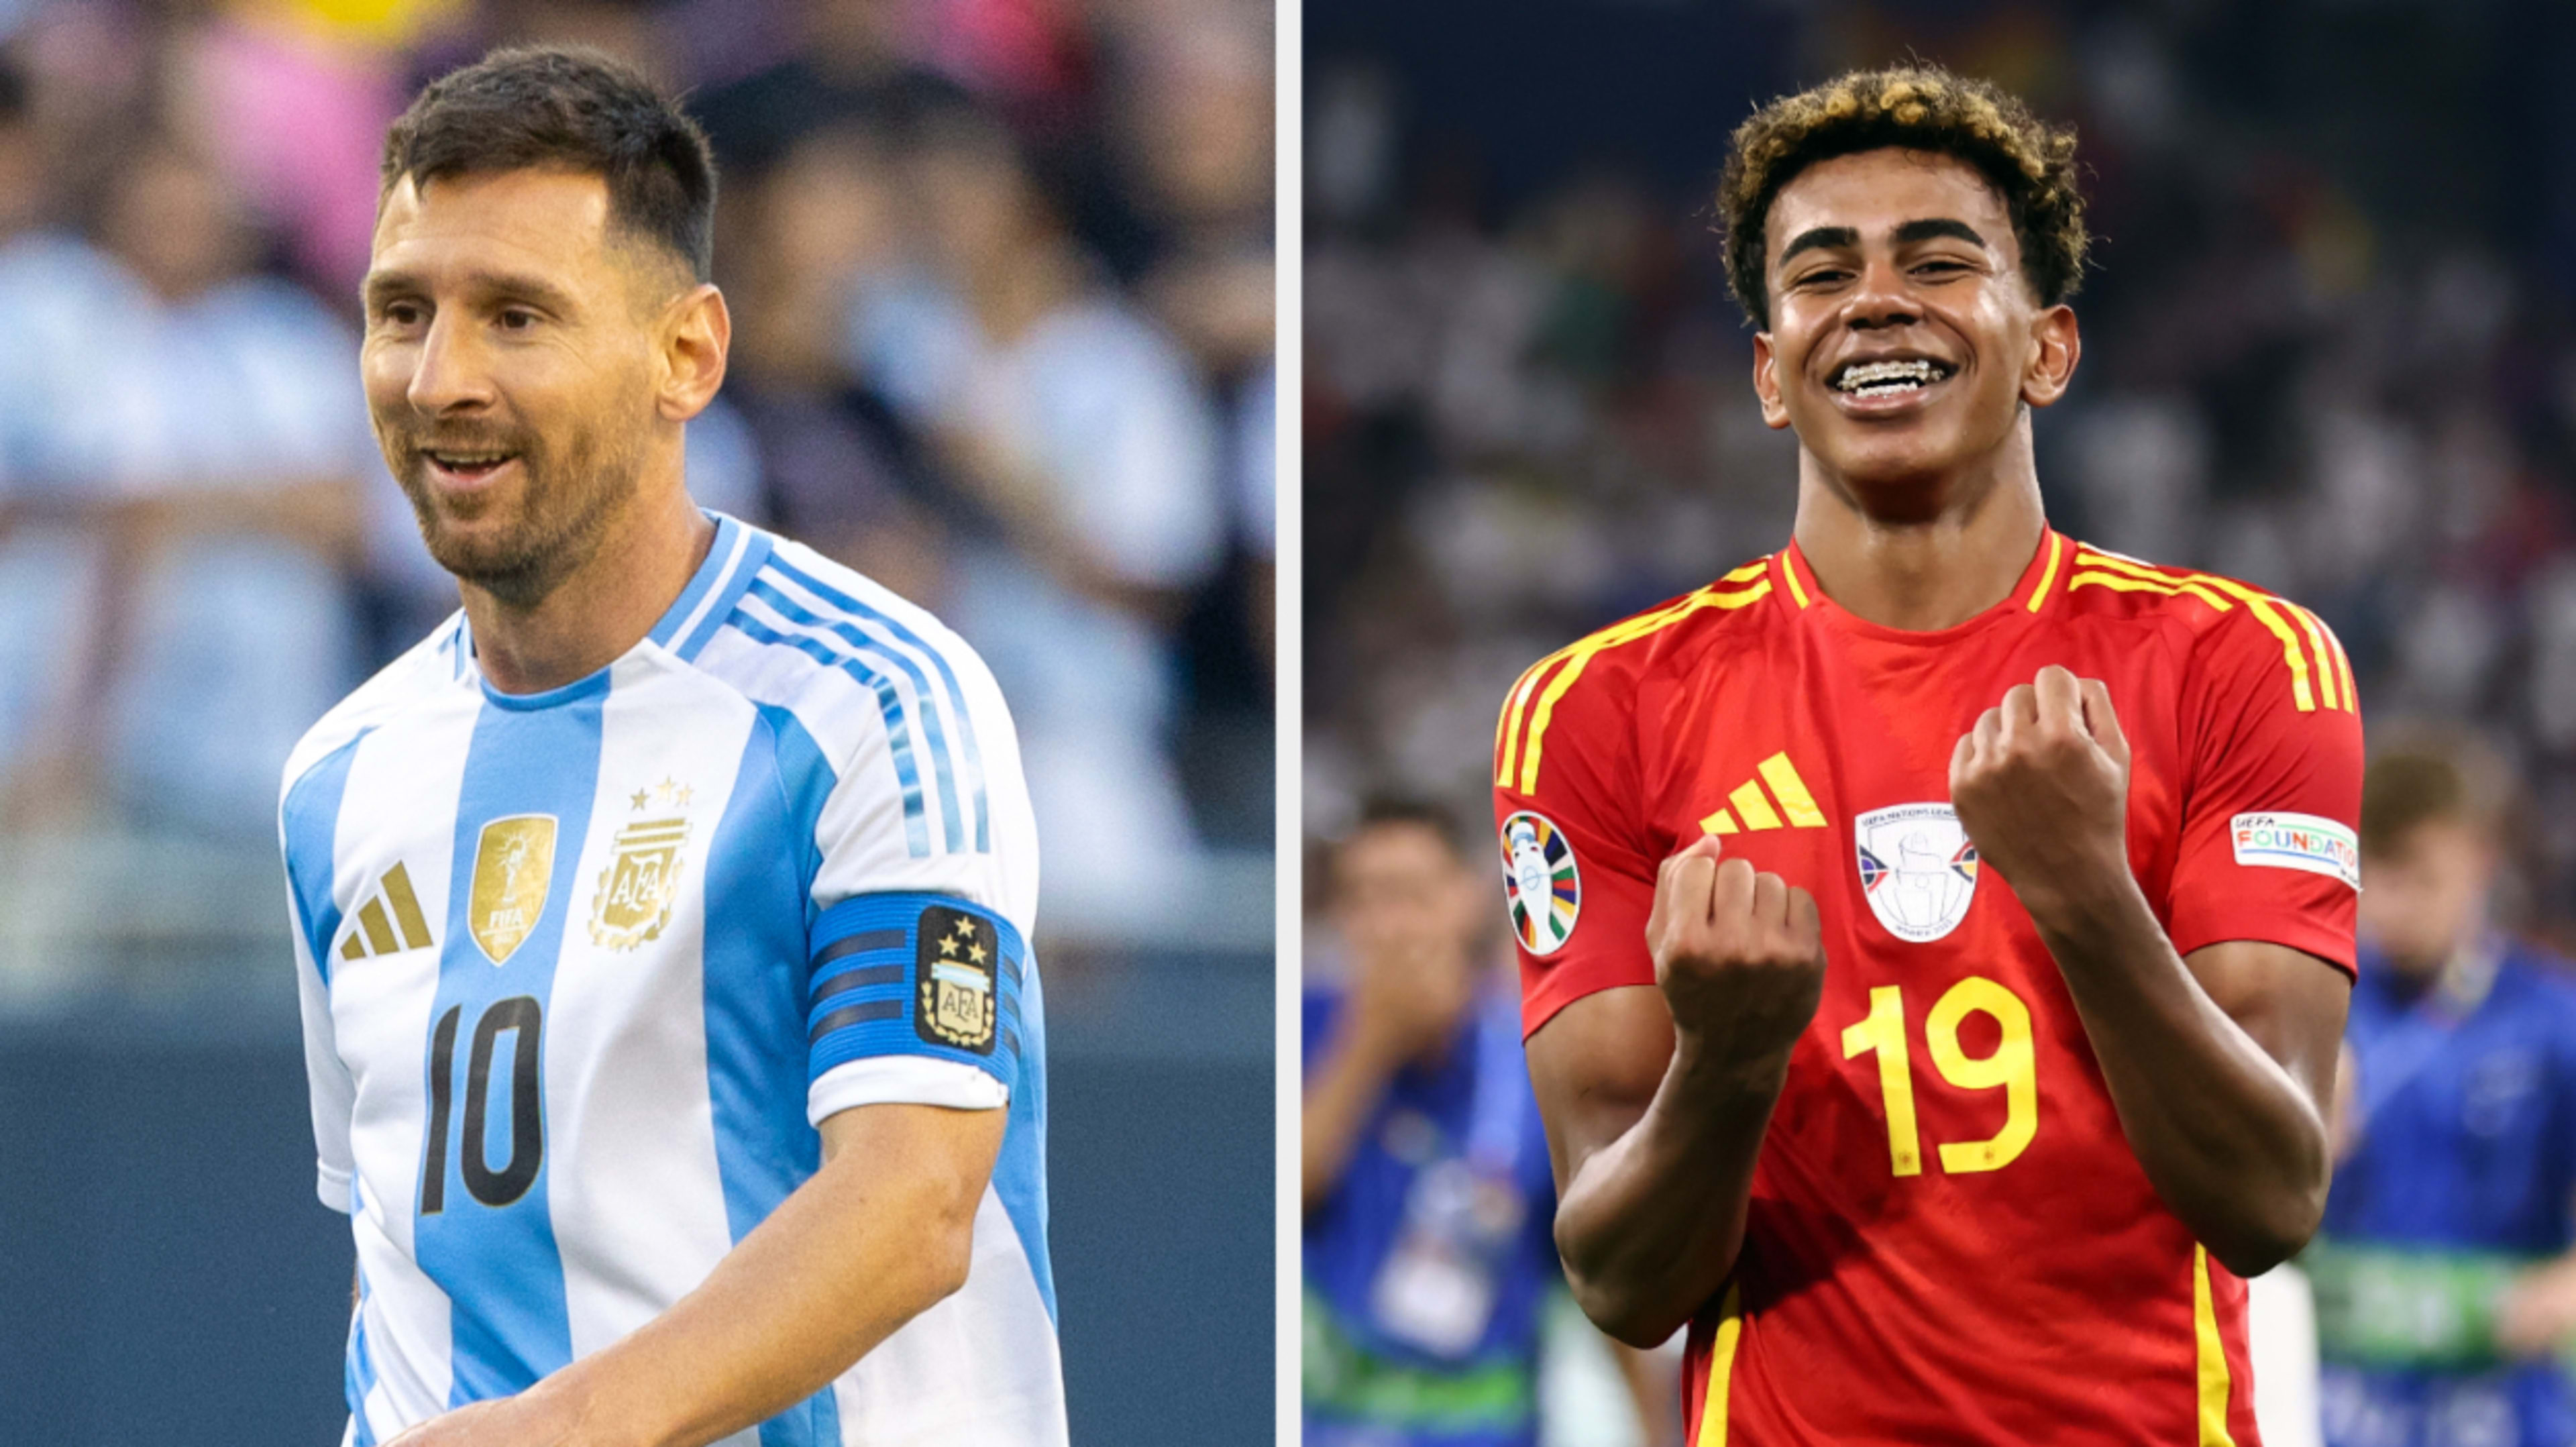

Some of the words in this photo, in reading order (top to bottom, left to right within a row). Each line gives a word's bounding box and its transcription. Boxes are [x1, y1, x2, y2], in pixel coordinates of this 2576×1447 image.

[1931, 808, 1955, 817] LEAG
[2235, 816, 2275, 828] UEFA
[2237, 830, 2359, 867] FOUNDATIO
[610, 853, 662, 911] AFA
[489, 907, 523, 929] FIFA
[942, 982, 979, 1022] AFA
[1841, 975, 2038, 1177] 19
[420, 994, 543, 1216] 10
